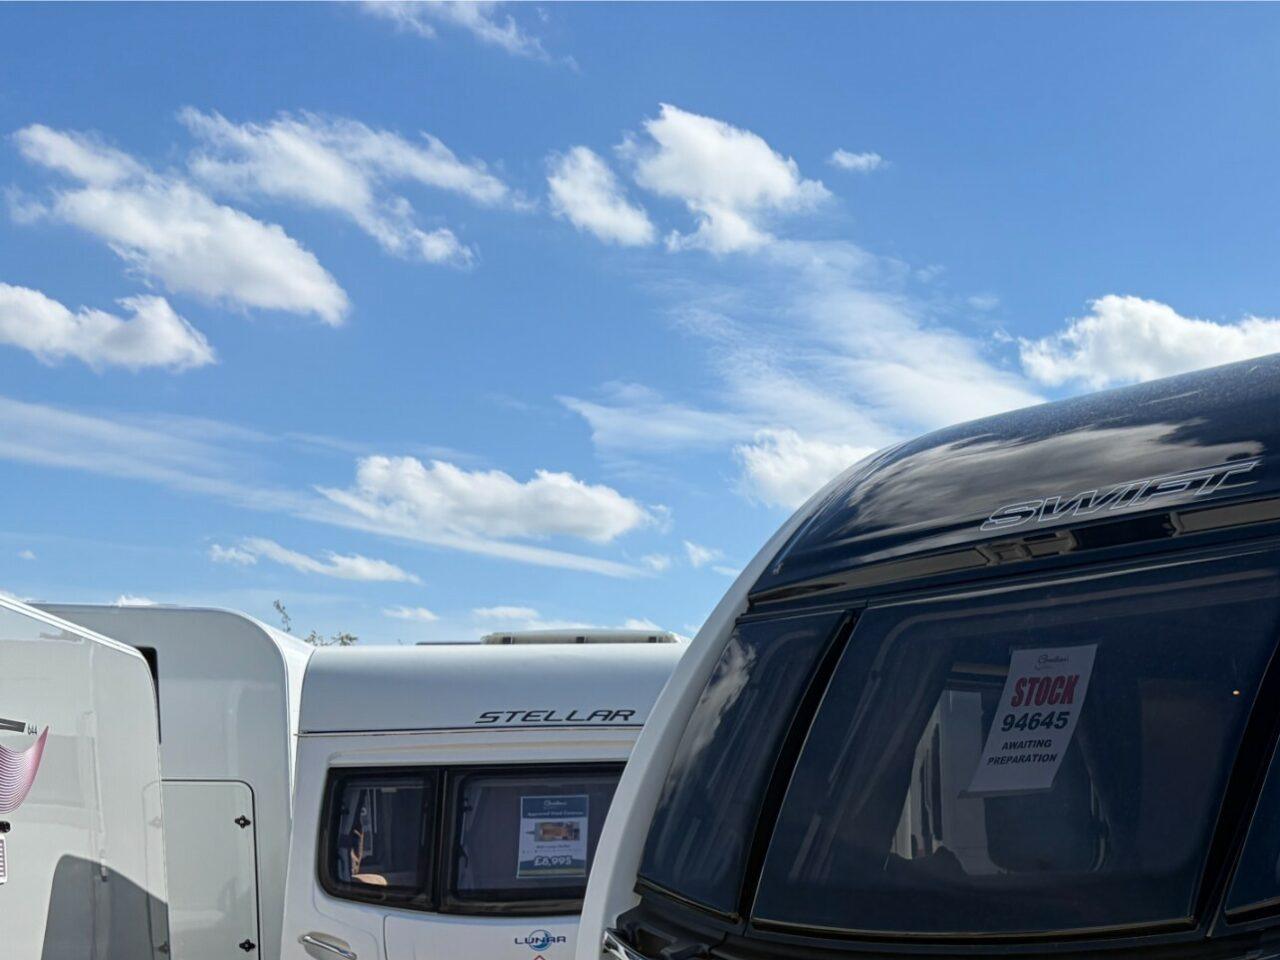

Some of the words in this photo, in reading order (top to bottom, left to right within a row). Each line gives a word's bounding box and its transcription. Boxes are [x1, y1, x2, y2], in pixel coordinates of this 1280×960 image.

[980, 456, 1263, 531] SWIFT
[1011, 675, 1080, 707] STOCK
[475, 709, 636, 724] STELLAR
[1001, 711, 1070, 732] 94645
[1001, 739, 1052, 751] AWAITING
[987, 753, 1058, 766] PREPARATION
[514, 935, 566, 945] LUNAR
